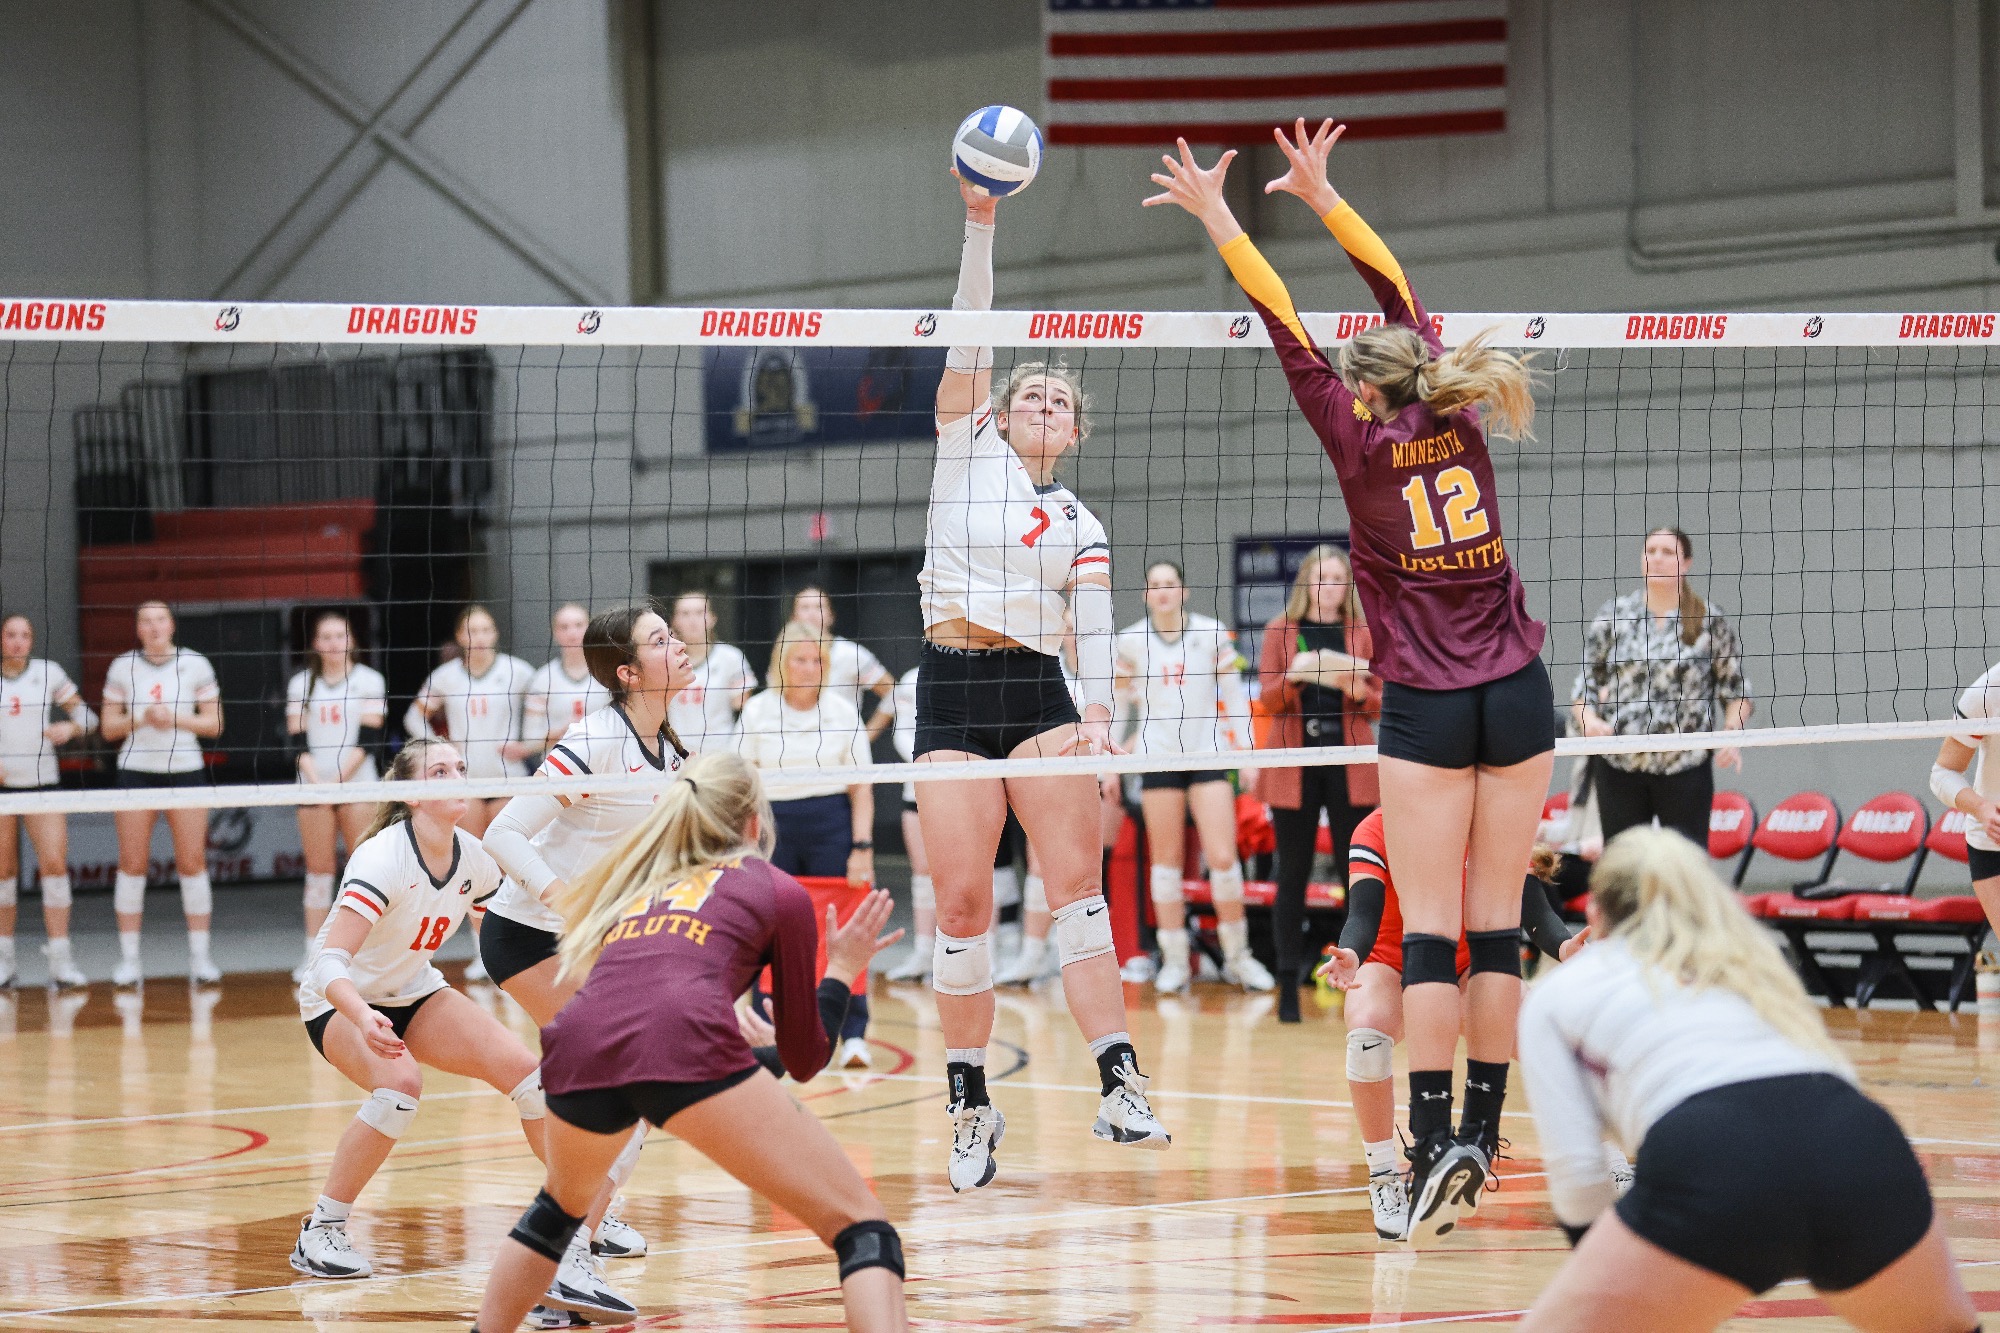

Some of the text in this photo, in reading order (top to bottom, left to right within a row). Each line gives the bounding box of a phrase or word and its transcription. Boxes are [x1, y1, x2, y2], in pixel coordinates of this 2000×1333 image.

[0, 303, 107, 332] AGONS
[347, 307, 479, 336] DRAGONS
[700, 311, 823, 338] DRAGONS
[1029, 313, 1144, 340] DRAGONS
[1625, 315, 1728, 341] DRAGONS
[1899, 315, 1996, 339] DRAGONS
[1402, 465, 1490, 550] 12
[409, 916, 451, 952] 18
[602, 914, 713, 946] ULUTH
